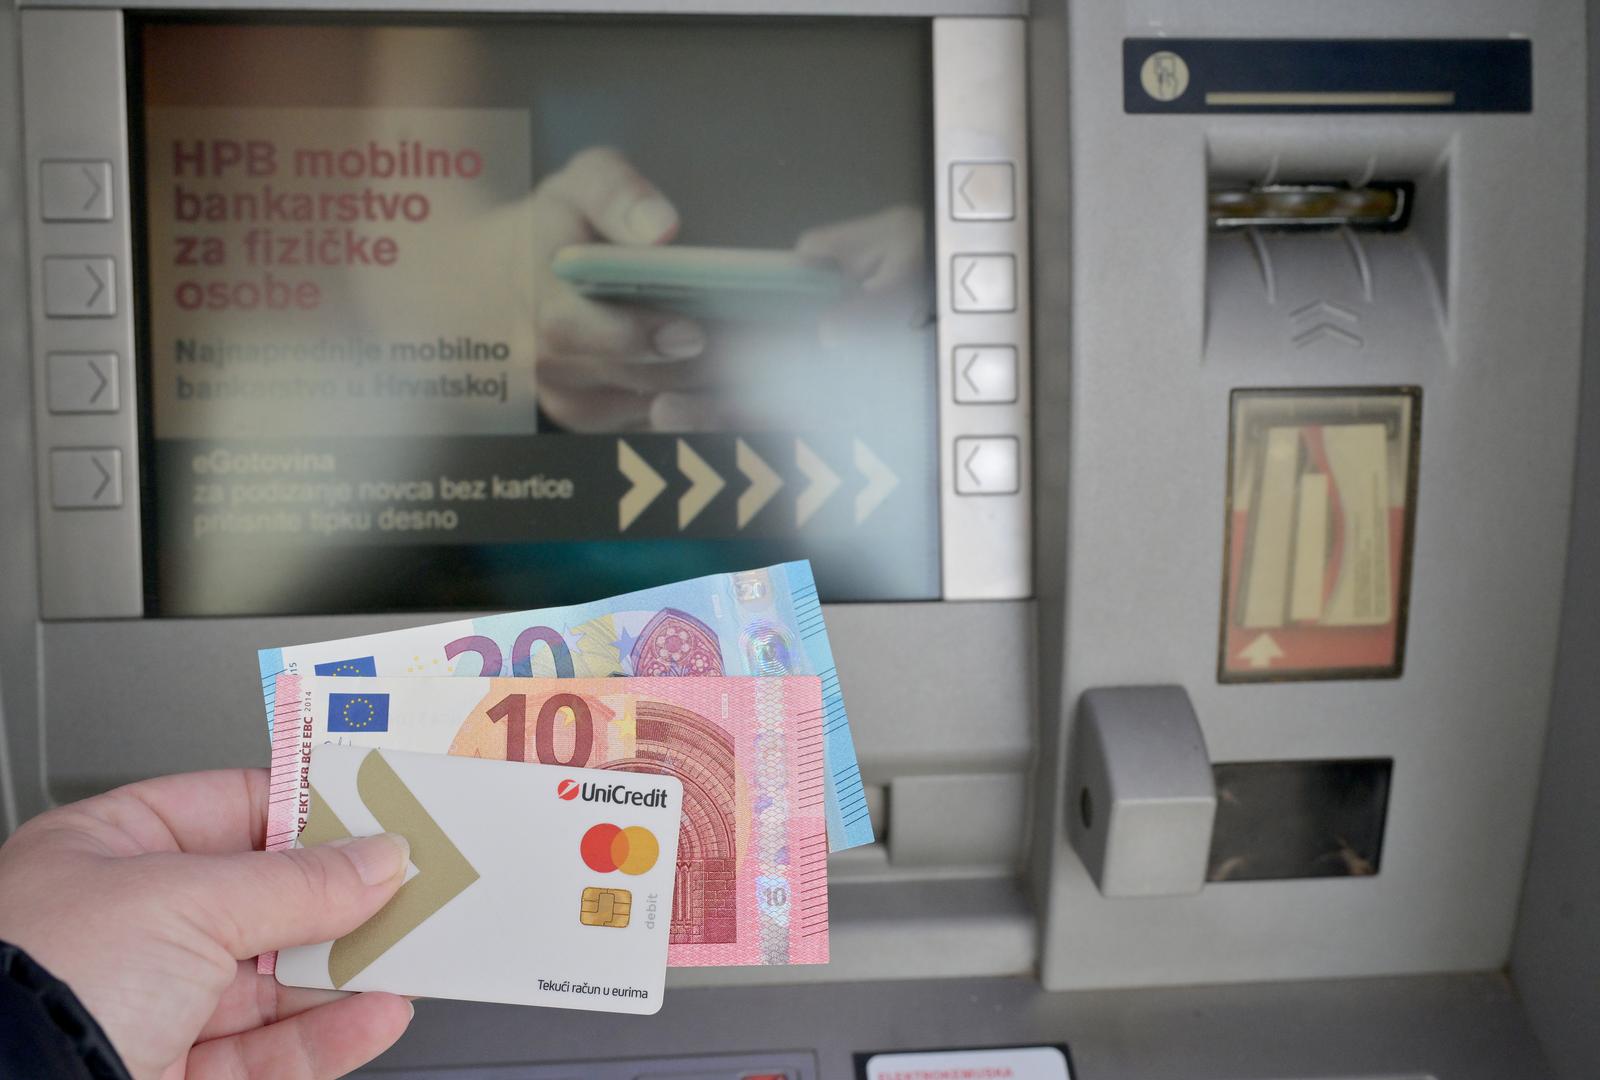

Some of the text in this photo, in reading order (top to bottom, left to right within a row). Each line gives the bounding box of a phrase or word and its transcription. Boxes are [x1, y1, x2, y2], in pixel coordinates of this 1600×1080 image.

[172, 140, 483, 179] HPB mobilno
[174, 185, 430, 223] bankarstvo
[174, 228, 398, 266] za fizičke
[175, 273, 321, 310] osobe
[175, 337, 510, 368] Najnaprednije mobilno
[177, 372, 508, 403] bankarstvo u Hrvatskoj
[191, 448, 335, 474] eGotovina
[192, 473, 575, 508] za podizanje novca bez kartice
[193, 508, 458, 539] pritisnite tipku desno
[288, 662, 298, 676] 15
[304, 691, 312, 712] 2014
[303, 717, 313, 738] EBC
[486, 693, 593, 768] 10
[299, 792, 308, 813] EKT
[581, 782, 667, 808] UniCredit
[644, 893, 658, 929] debit
[537, 979, 648, 999] Tekući račun u eurima
